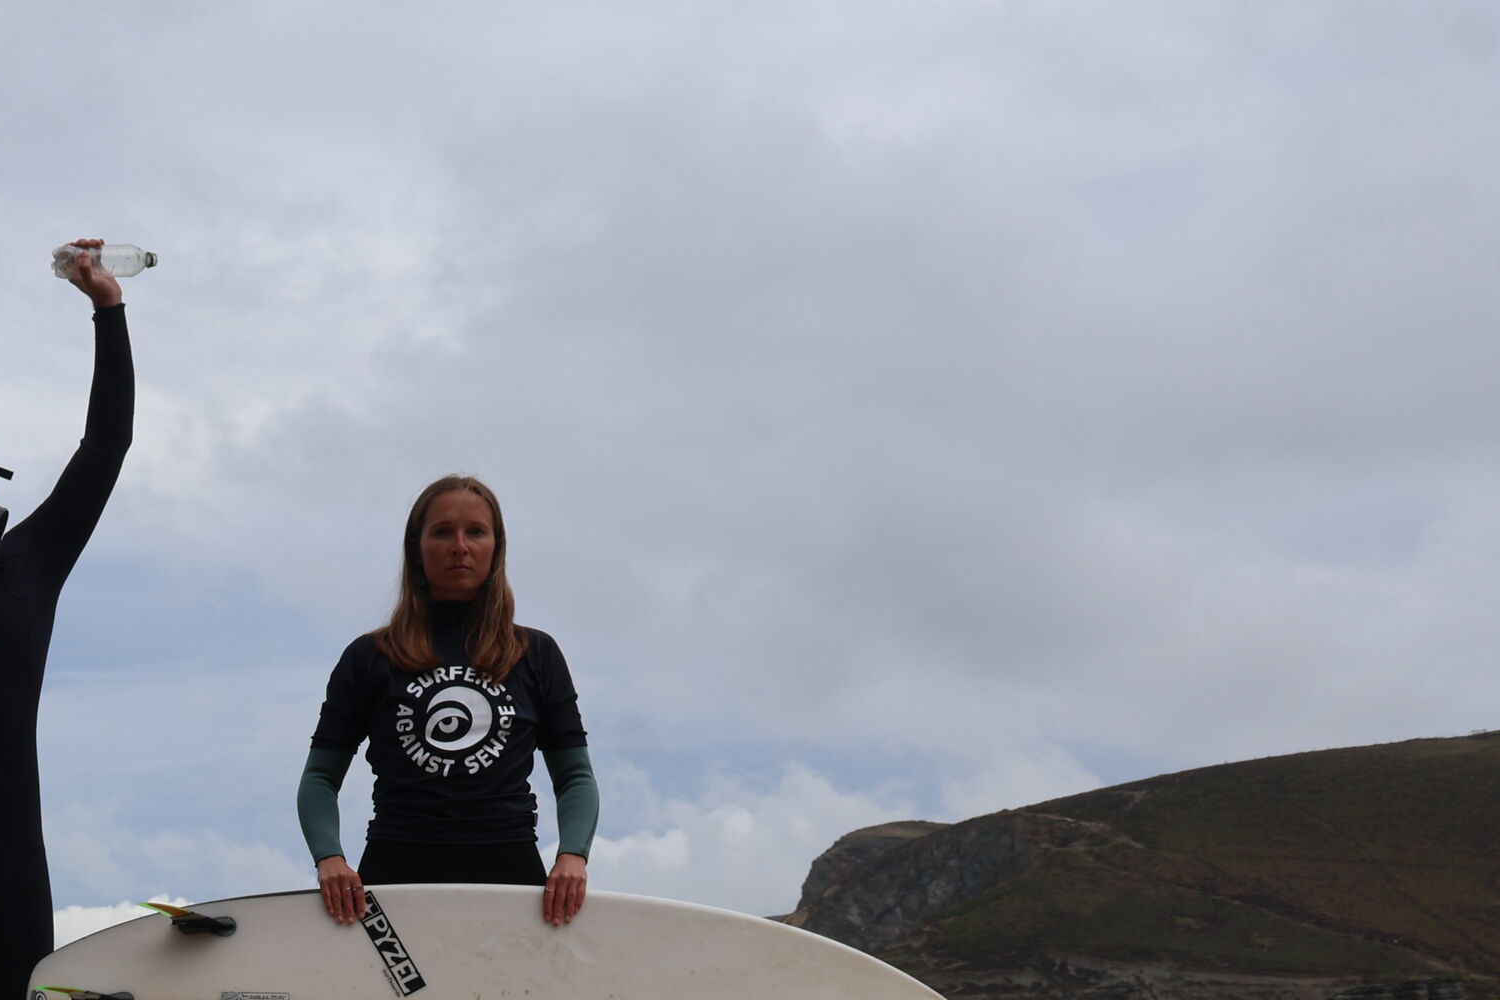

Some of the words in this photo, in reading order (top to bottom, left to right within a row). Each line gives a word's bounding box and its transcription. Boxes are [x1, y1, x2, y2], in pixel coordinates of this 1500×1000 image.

[406, 665, 506, 699] SURFERS
[396, 703, 456, 778] AGAINST
[364, 916, 420, 995] PYZEL
